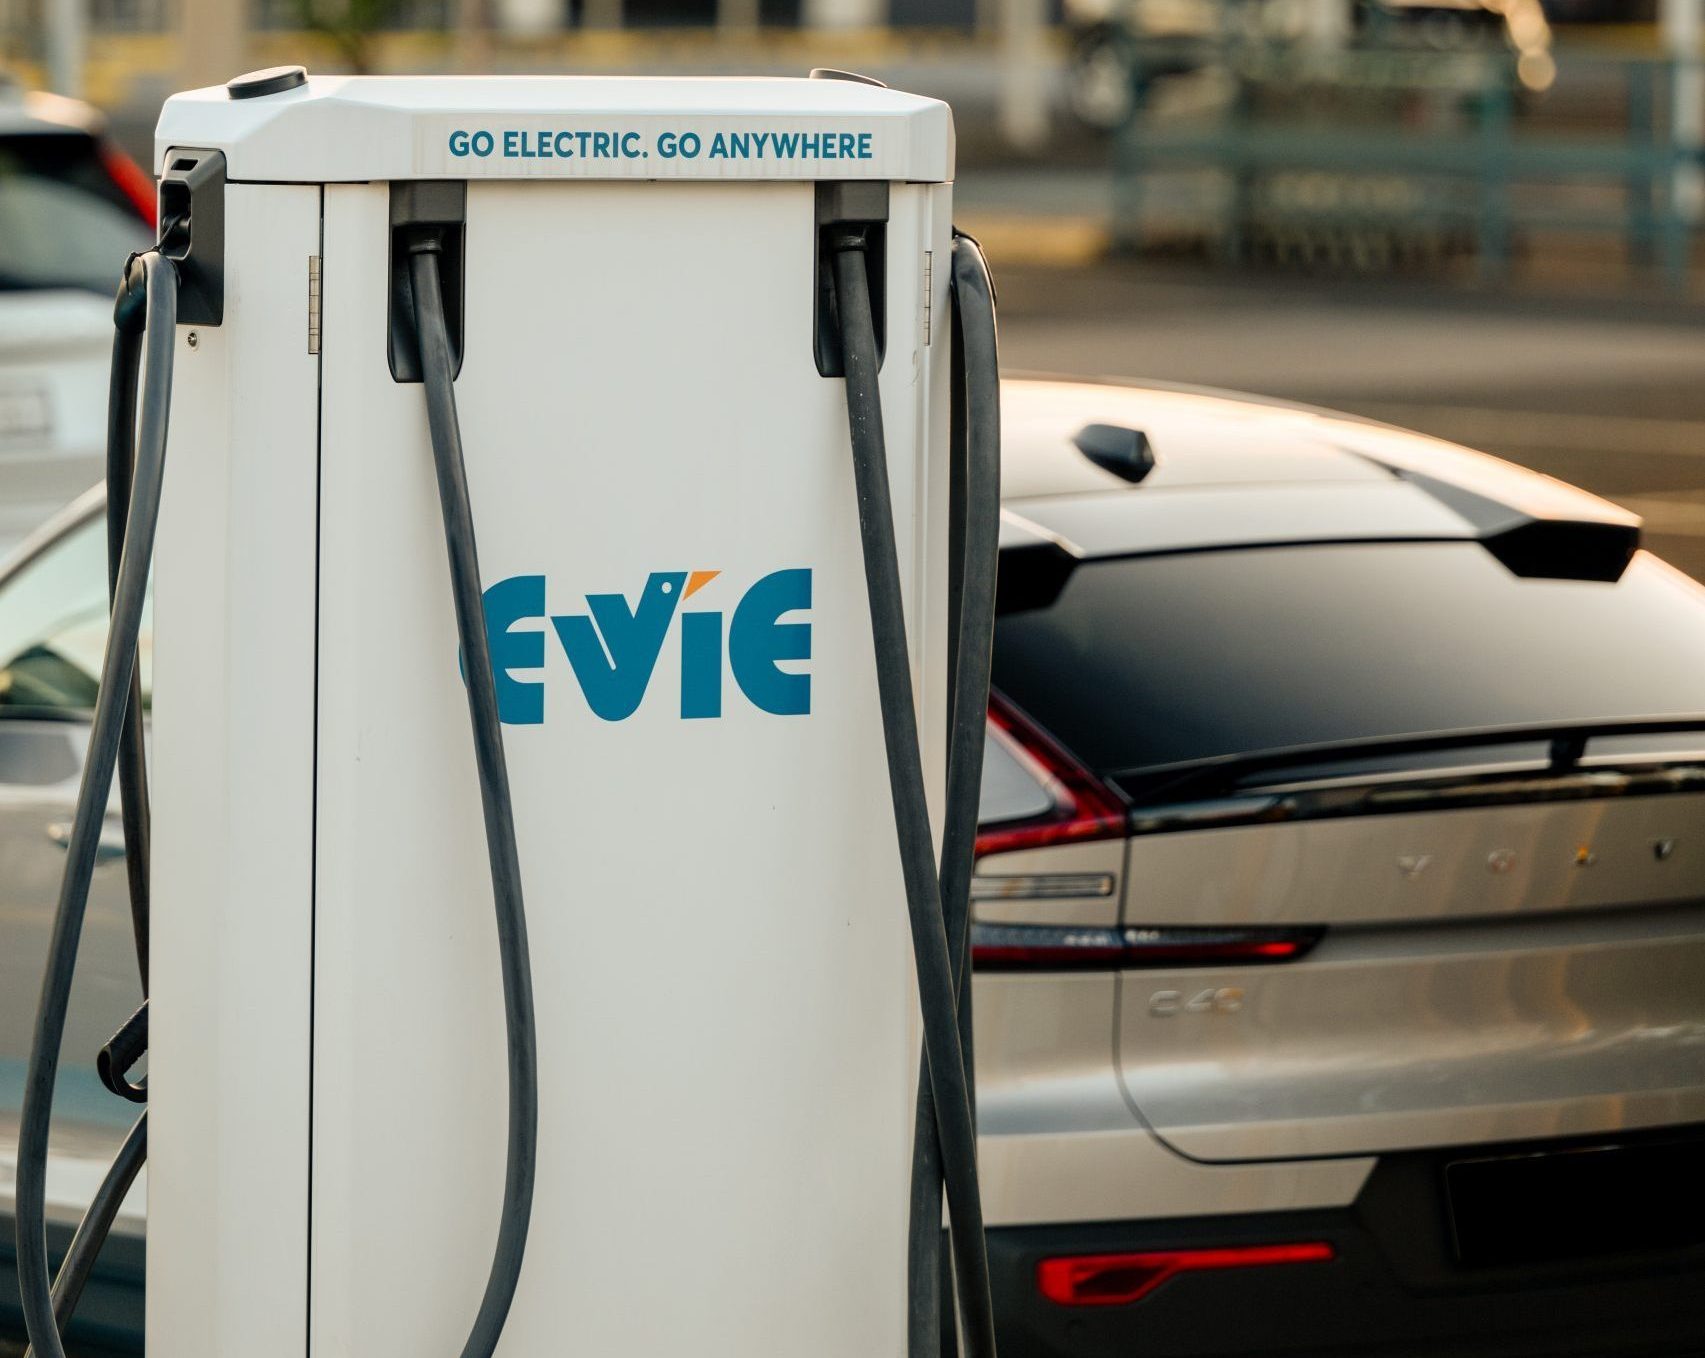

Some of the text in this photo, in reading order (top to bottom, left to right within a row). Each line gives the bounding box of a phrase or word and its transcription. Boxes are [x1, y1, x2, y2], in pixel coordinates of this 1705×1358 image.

[449, 130, 873, 160] GO ELECTRIC. GO ANYWHERE
